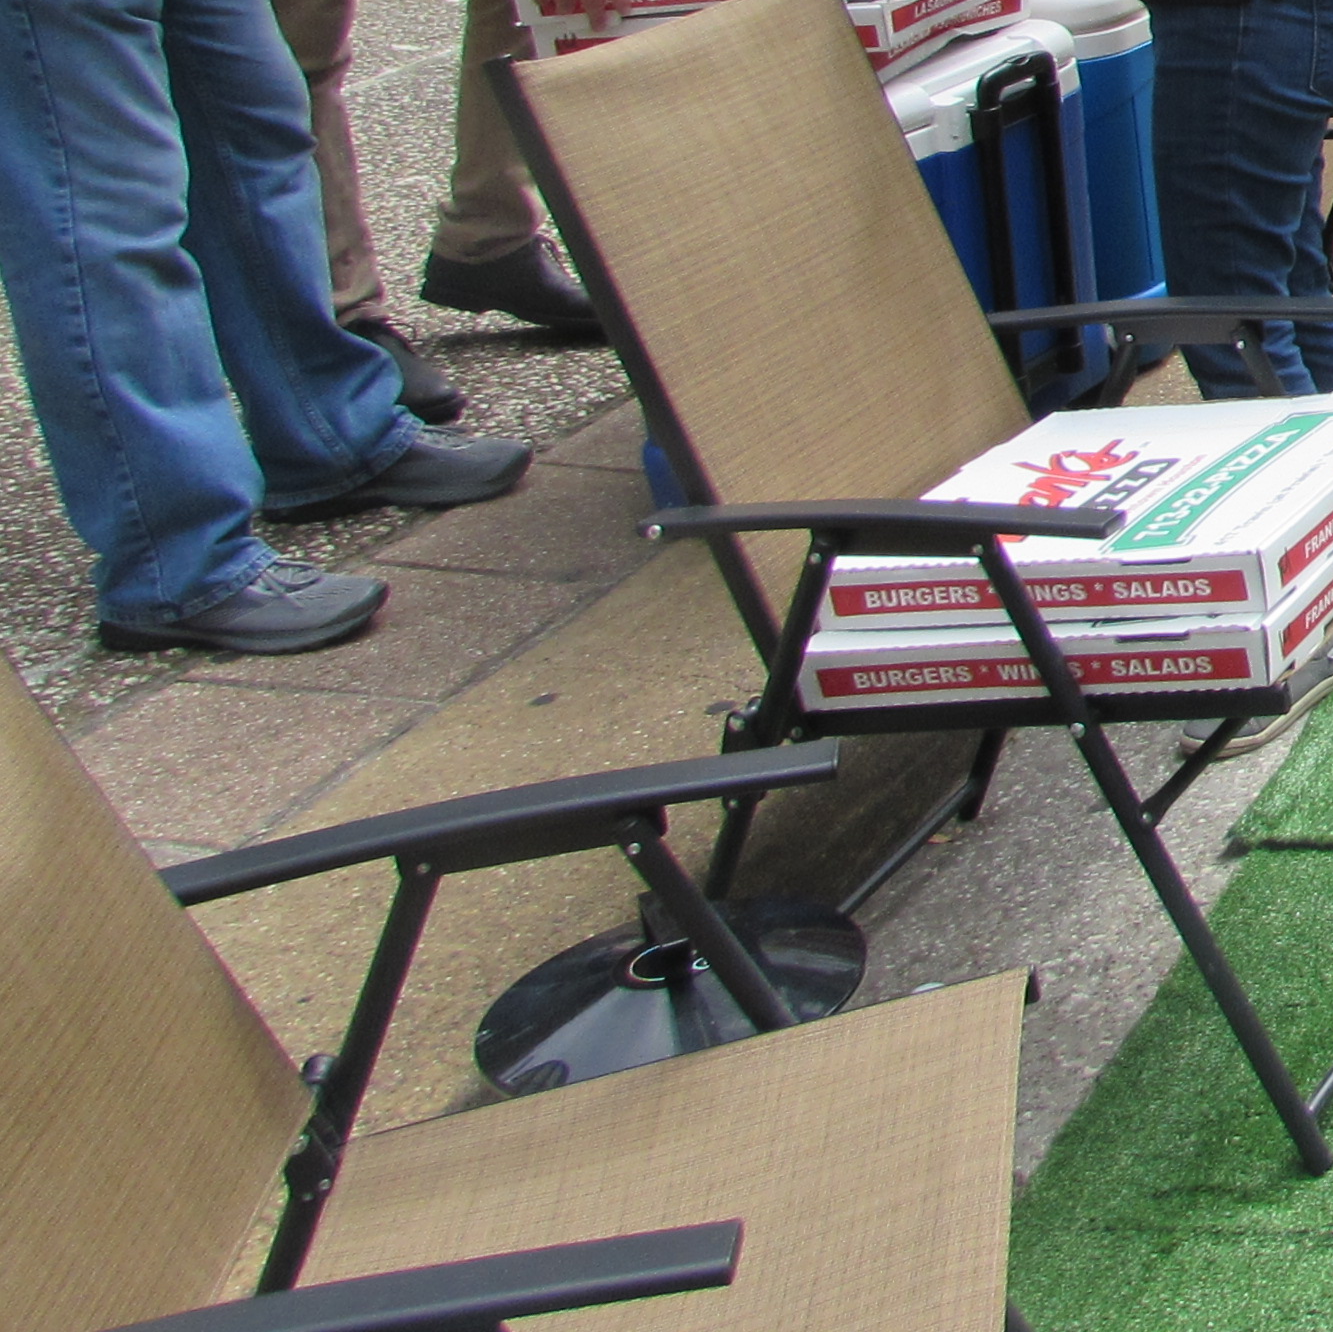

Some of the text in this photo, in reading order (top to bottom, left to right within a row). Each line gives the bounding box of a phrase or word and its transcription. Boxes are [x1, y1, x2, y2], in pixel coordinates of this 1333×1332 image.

[1097, 460, 1172, 509] ZZA
[864, 577, 1212, 609] BURGERS INGS SALADS
[853, 664, 974, 690] BURGERS
[1111, 656, 1212, 677] SALADS
